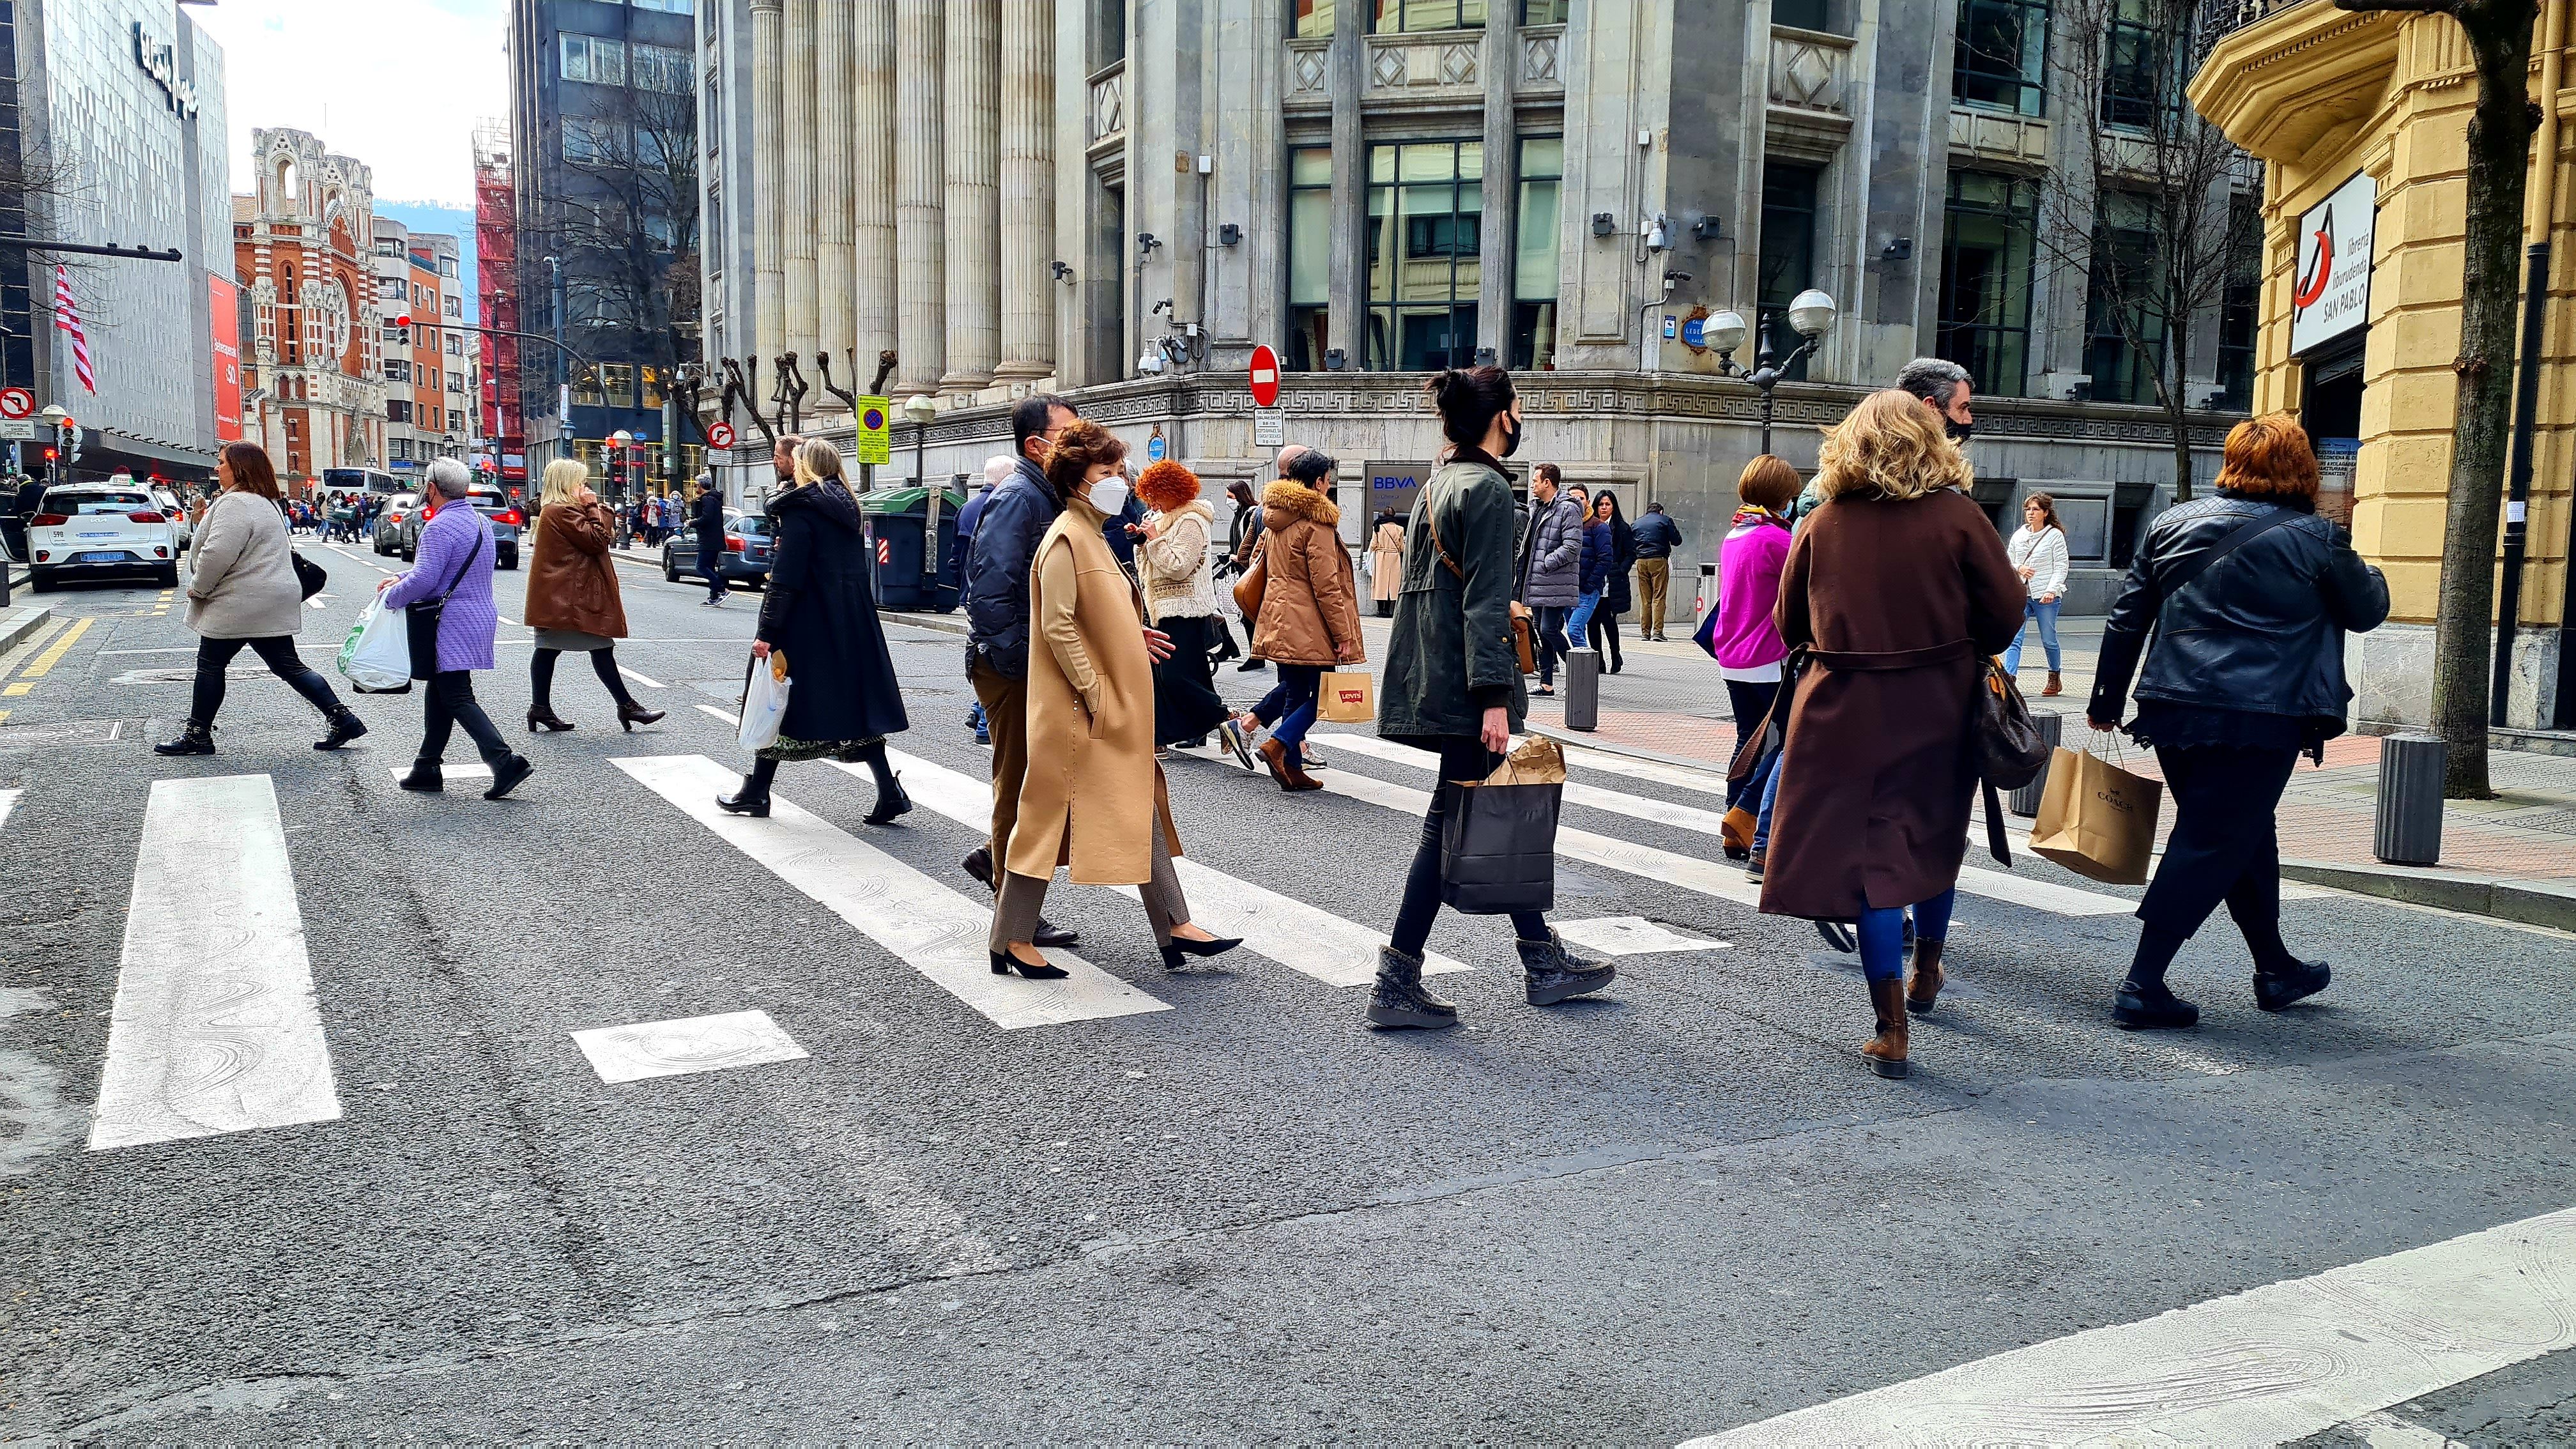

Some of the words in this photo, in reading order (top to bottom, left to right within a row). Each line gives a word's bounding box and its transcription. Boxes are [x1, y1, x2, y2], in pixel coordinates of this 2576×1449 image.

[2347, 229, 2369, 257] librería
[2332, 259, 2367, 291] liburudenda
[2324, 295, 2339, 323] SAN
[2340, 282, 2365, 312] PABLO
[1374, 475, 1416, 489] BBVA
[2097, 792, 2133, 811] COACH
